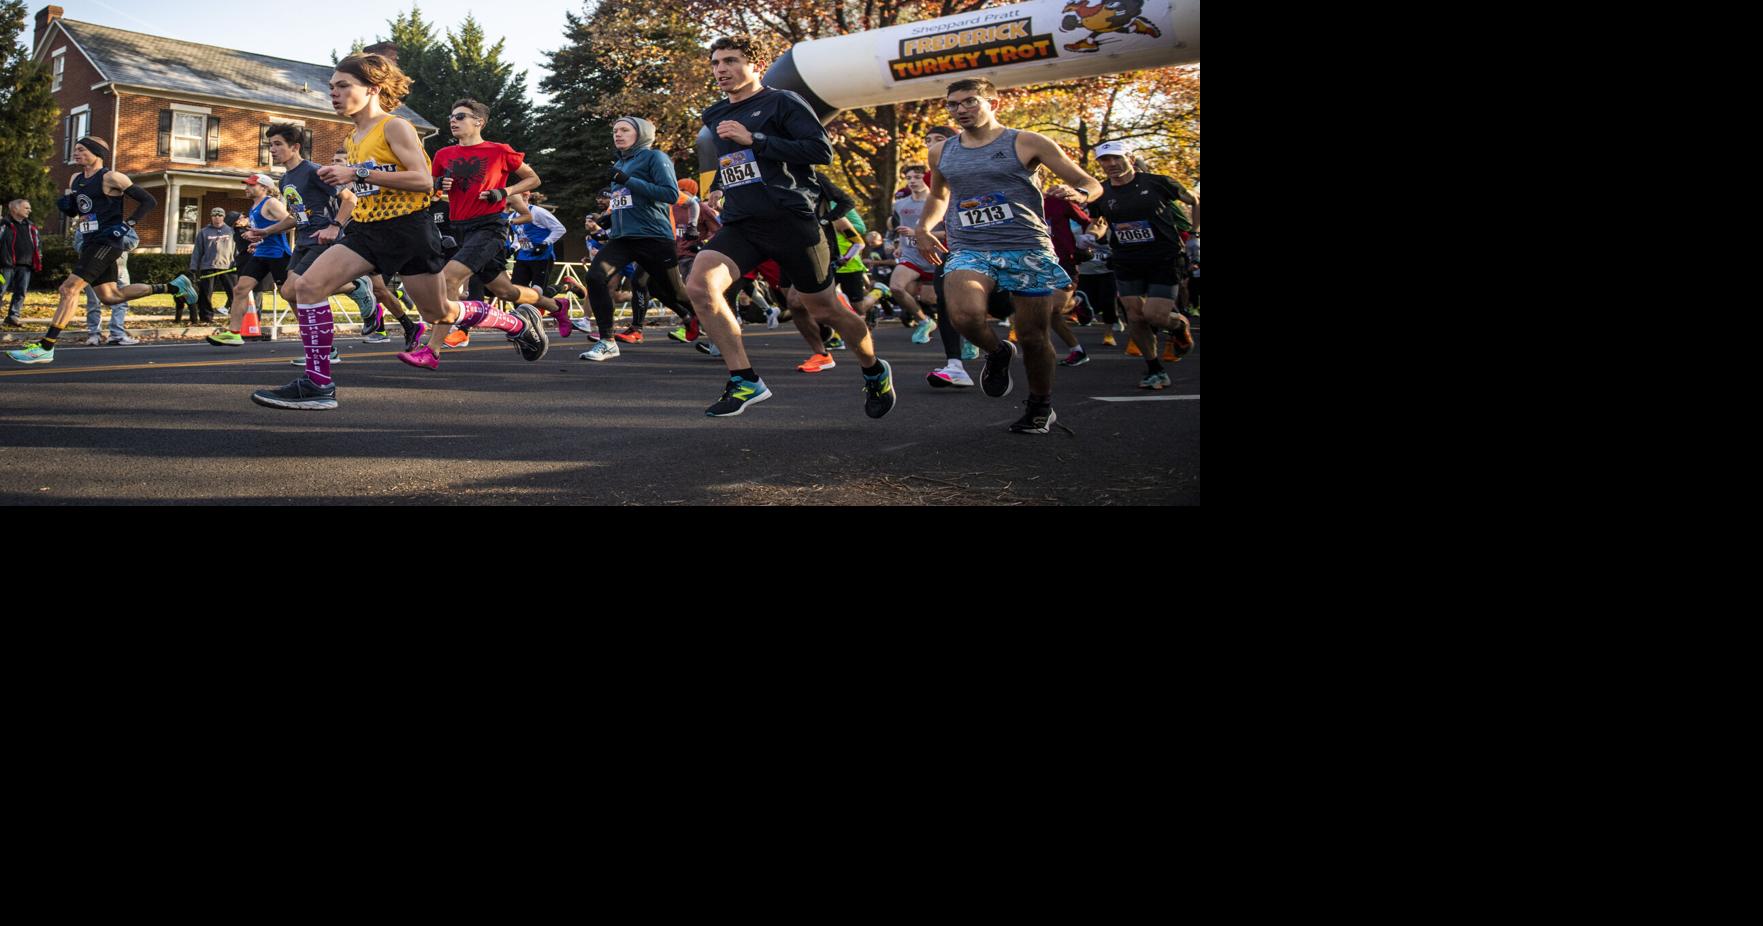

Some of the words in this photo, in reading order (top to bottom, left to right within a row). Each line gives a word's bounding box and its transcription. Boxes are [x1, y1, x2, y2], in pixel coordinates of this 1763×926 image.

[912, 14, 980, 34] Sheppard
[984, 9, 1020, 22] Pratt
[904, 20, 1029, 57] FREDERICK
[893, 51, 981, 78] TURKEY
[985, 39, 1050, 64] TROT
[722, 163, 756, 184] 1854
[965, 206, 1006, 225] 1213
[1119, 228, 1153, 241] 2068
